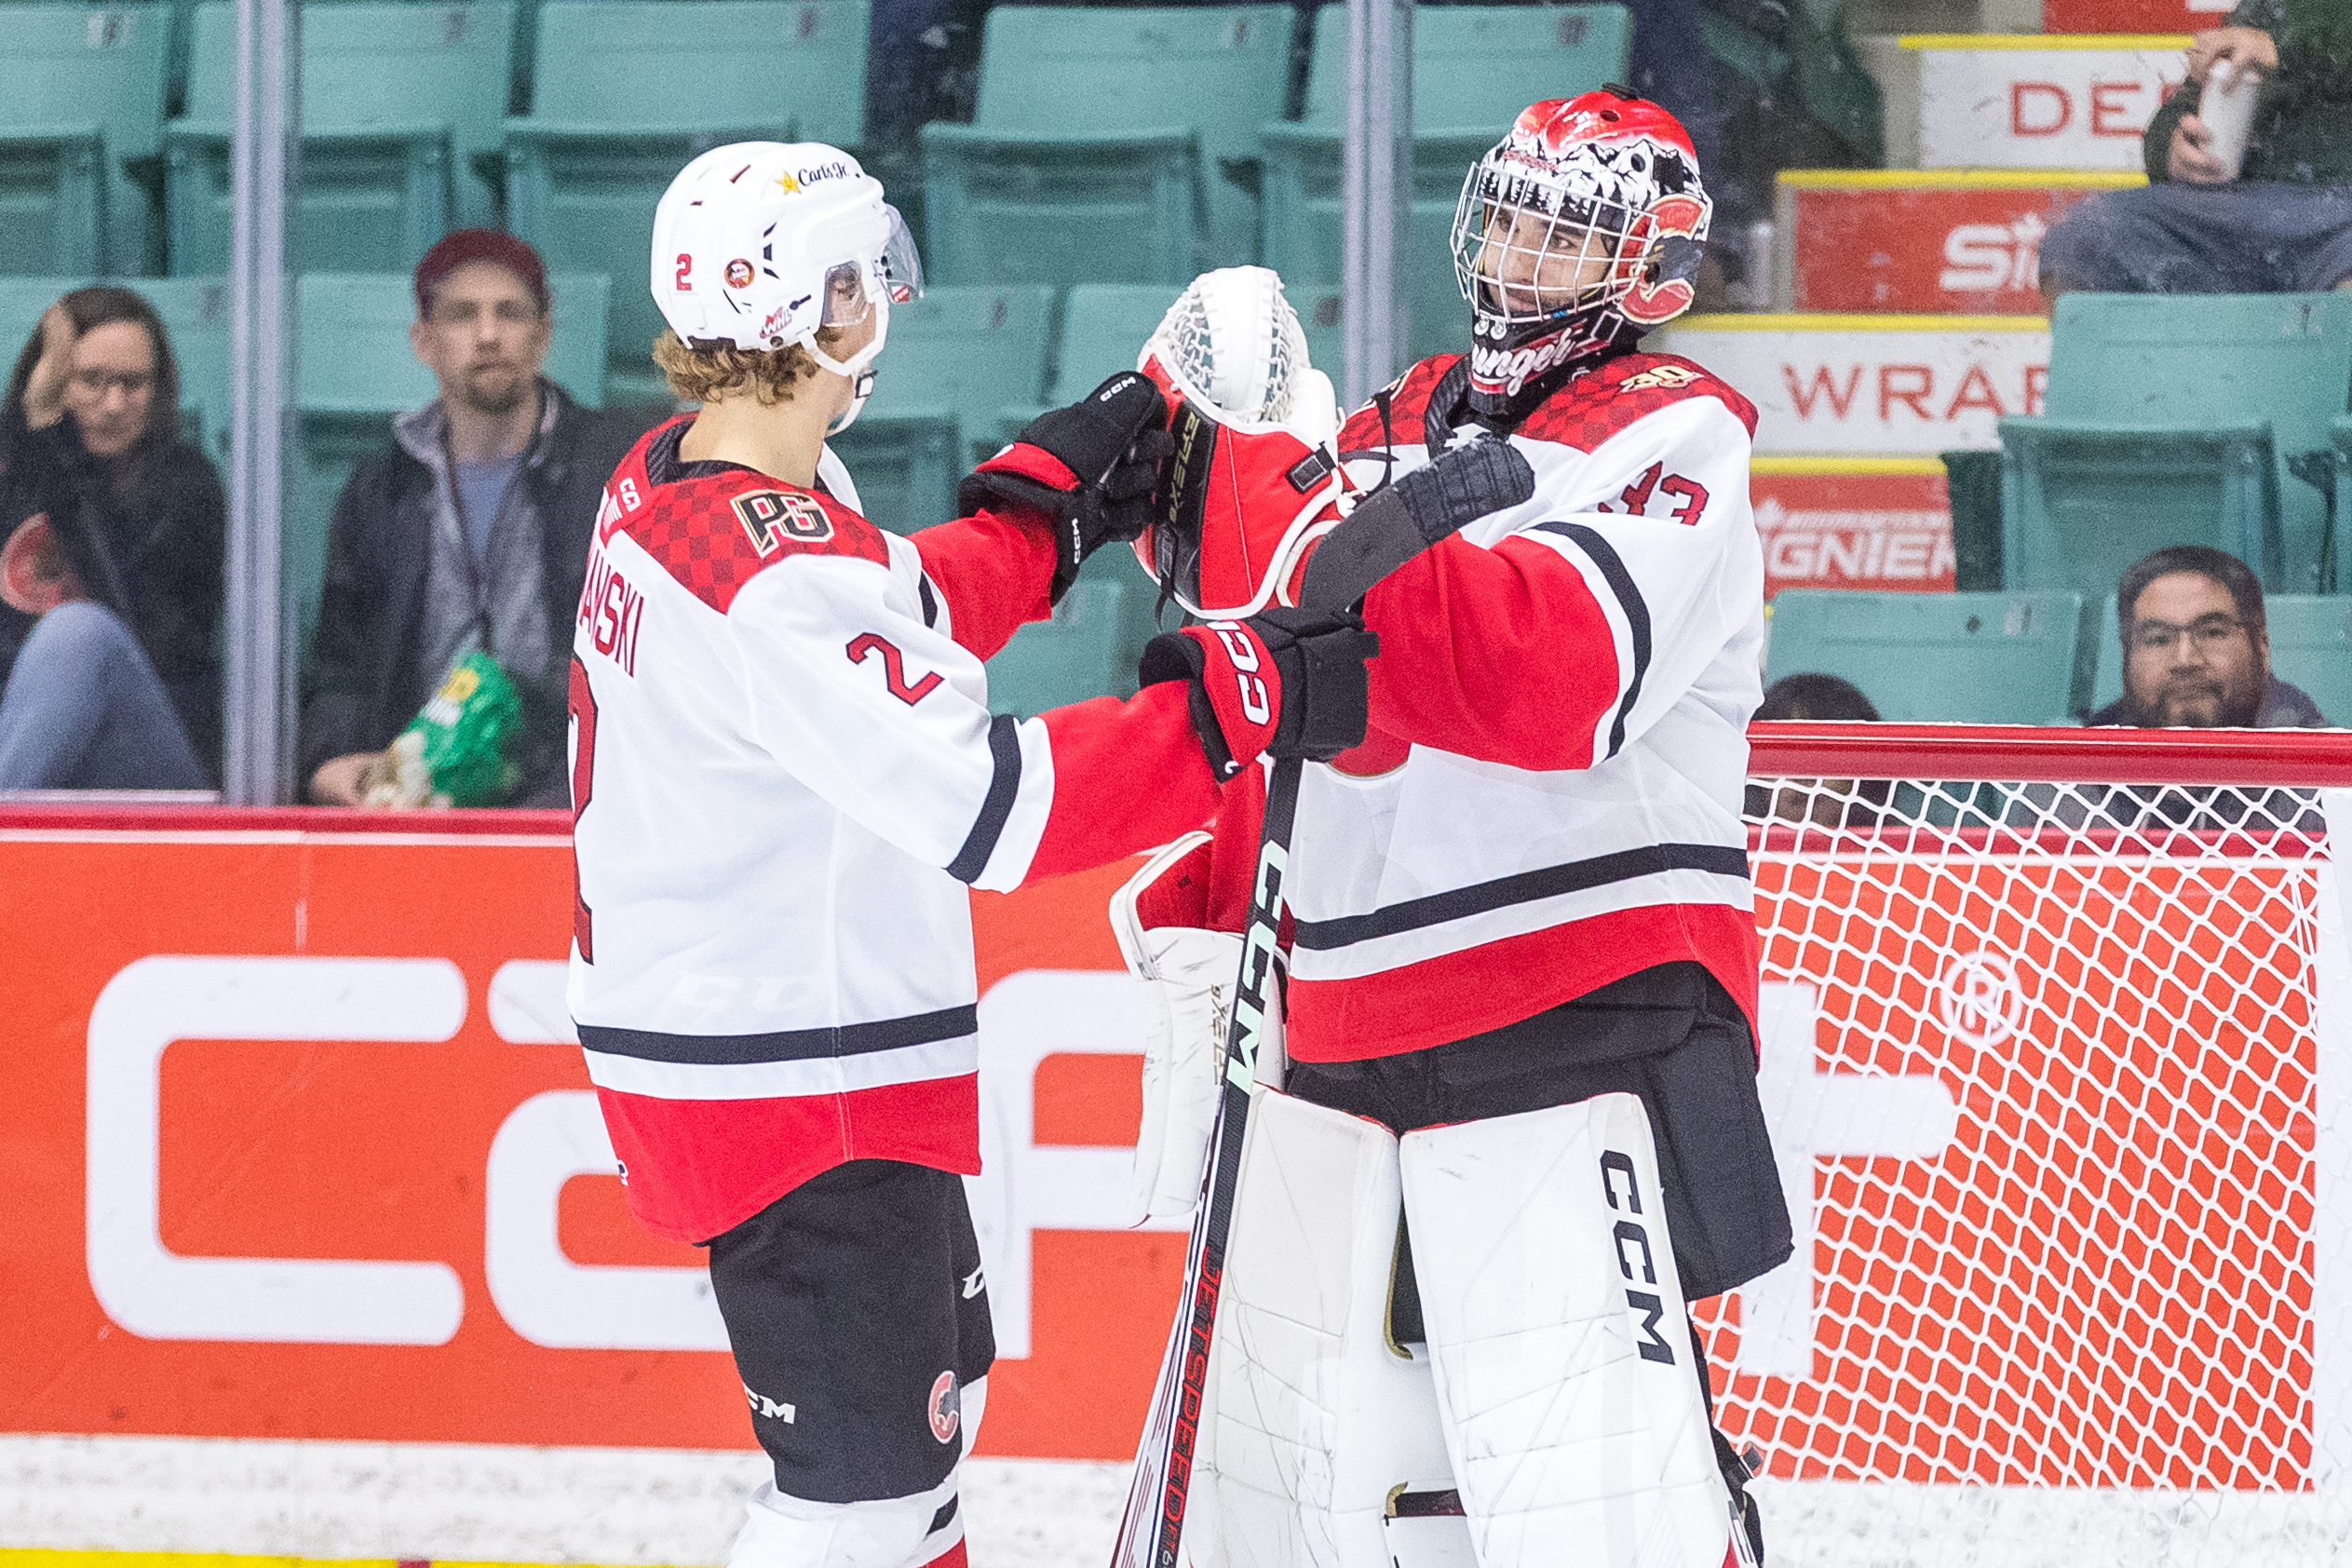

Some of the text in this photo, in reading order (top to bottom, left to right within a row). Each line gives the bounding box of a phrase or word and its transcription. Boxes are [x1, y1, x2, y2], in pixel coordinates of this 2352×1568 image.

[2010, 81, 2182, 138] DE
[676, 252, 693, 291] 2
[1100, 376, 1137, 402] CCM
[845, 631, 946, 708] 2
[1225, 839, 1290, 1097] CCM
[1600, 1149, 1677, 1366] CCM
[1163, 1246, 1222, 1523] JETSPEED
